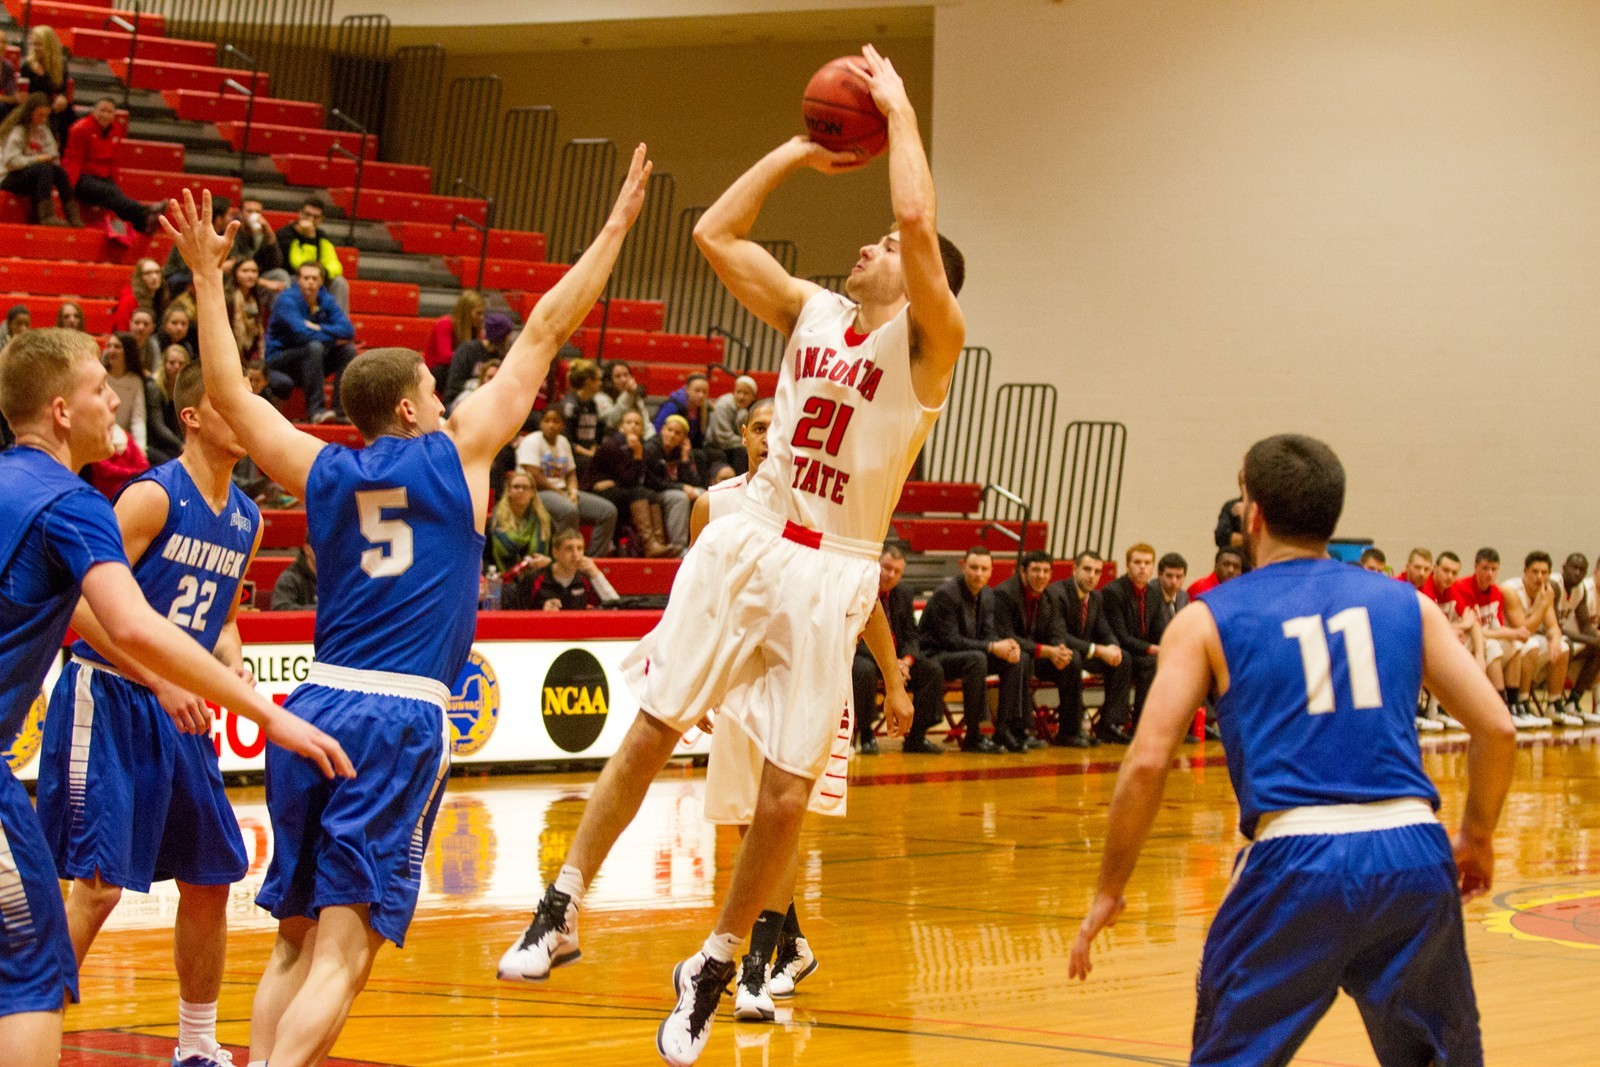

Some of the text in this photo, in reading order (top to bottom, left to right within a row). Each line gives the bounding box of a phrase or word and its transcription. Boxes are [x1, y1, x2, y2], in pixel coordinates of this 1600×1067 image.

[791, 395, 855, 457] 21
[791, 456, 850, 505] TATE
[161, 533, 246, 579] HARTWICK
[354, 486, 414, 579] 5
[167, 574, 217, 632] 22
[242, 656, 316, 682] OLLEG
[1282, 606, 1383, 715] 11
[543, 685, 609, 715] NCAA
